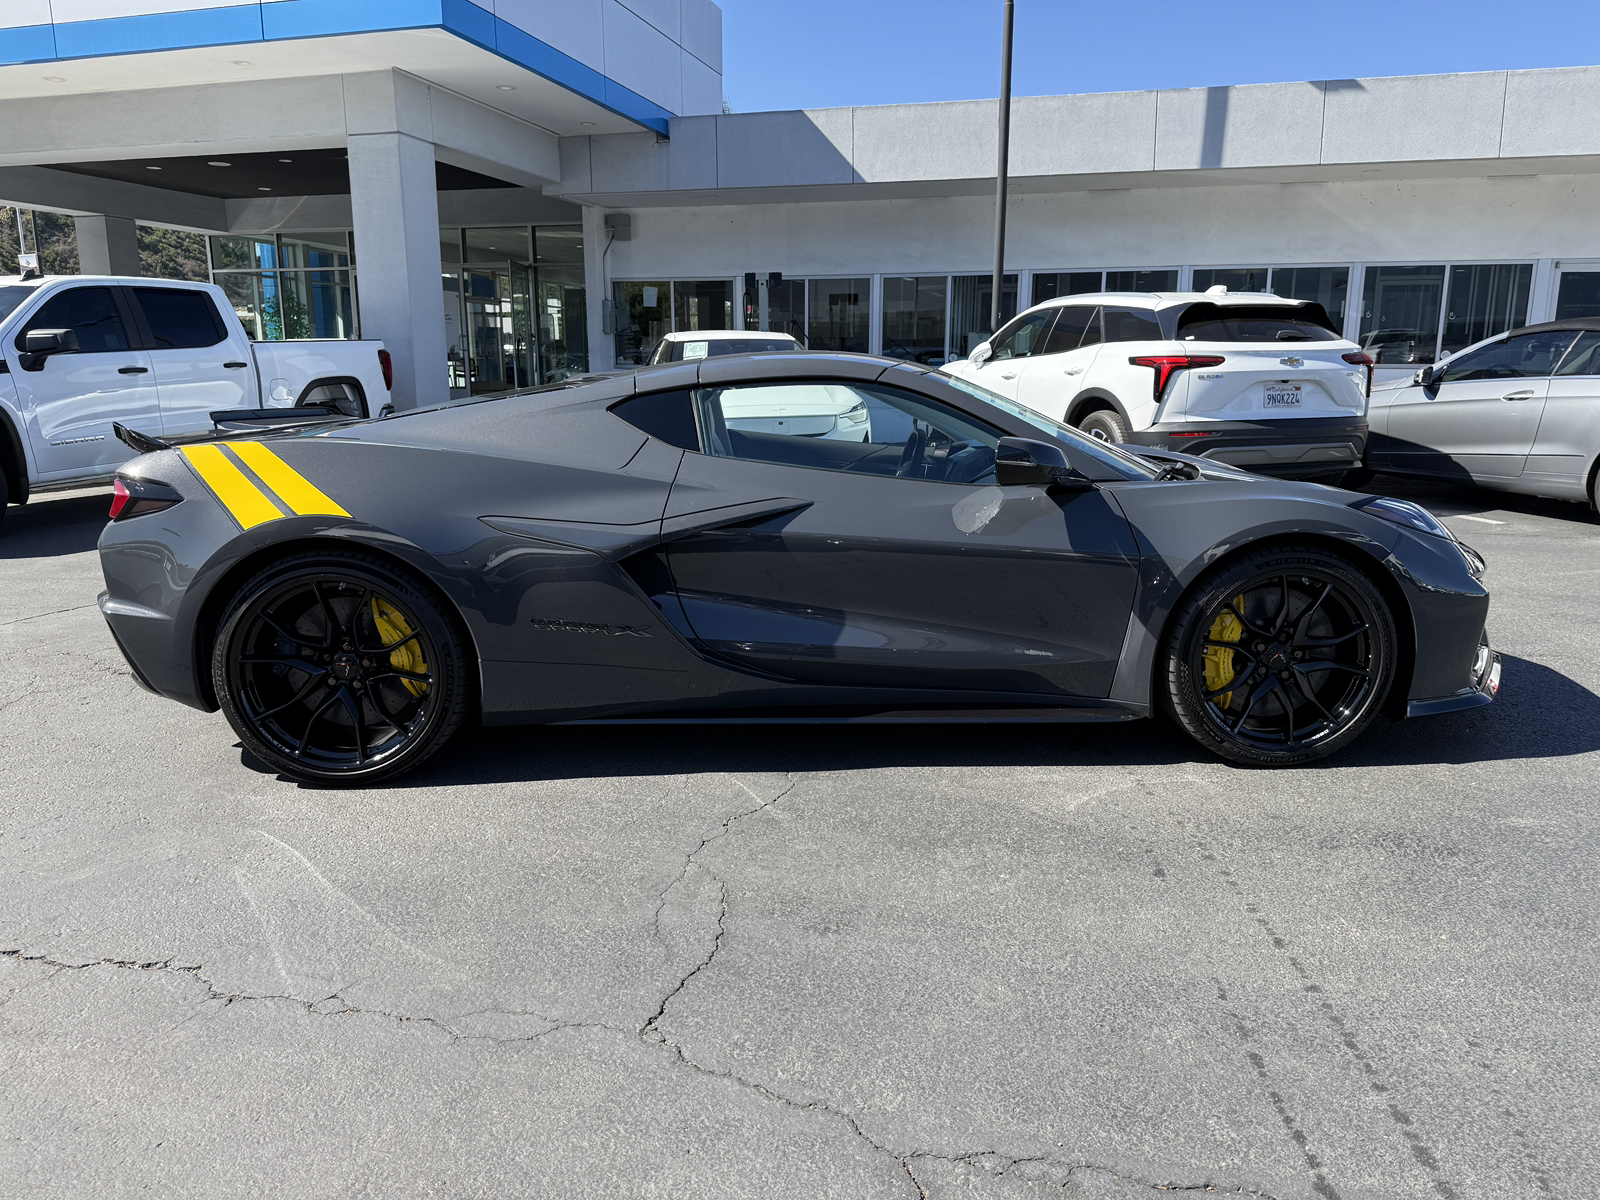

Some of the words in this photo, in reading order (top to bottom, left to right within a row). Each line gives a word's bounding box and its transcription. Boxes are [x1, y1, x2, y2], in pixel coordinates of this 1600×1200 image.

[1266, 392, 1300, 405] 9NQK224
[51, 436, 104, 446] SIERRA
[1269, 557, 1317, 566] MICHELIN
[443, 657, 454, 709] MICHELIN
